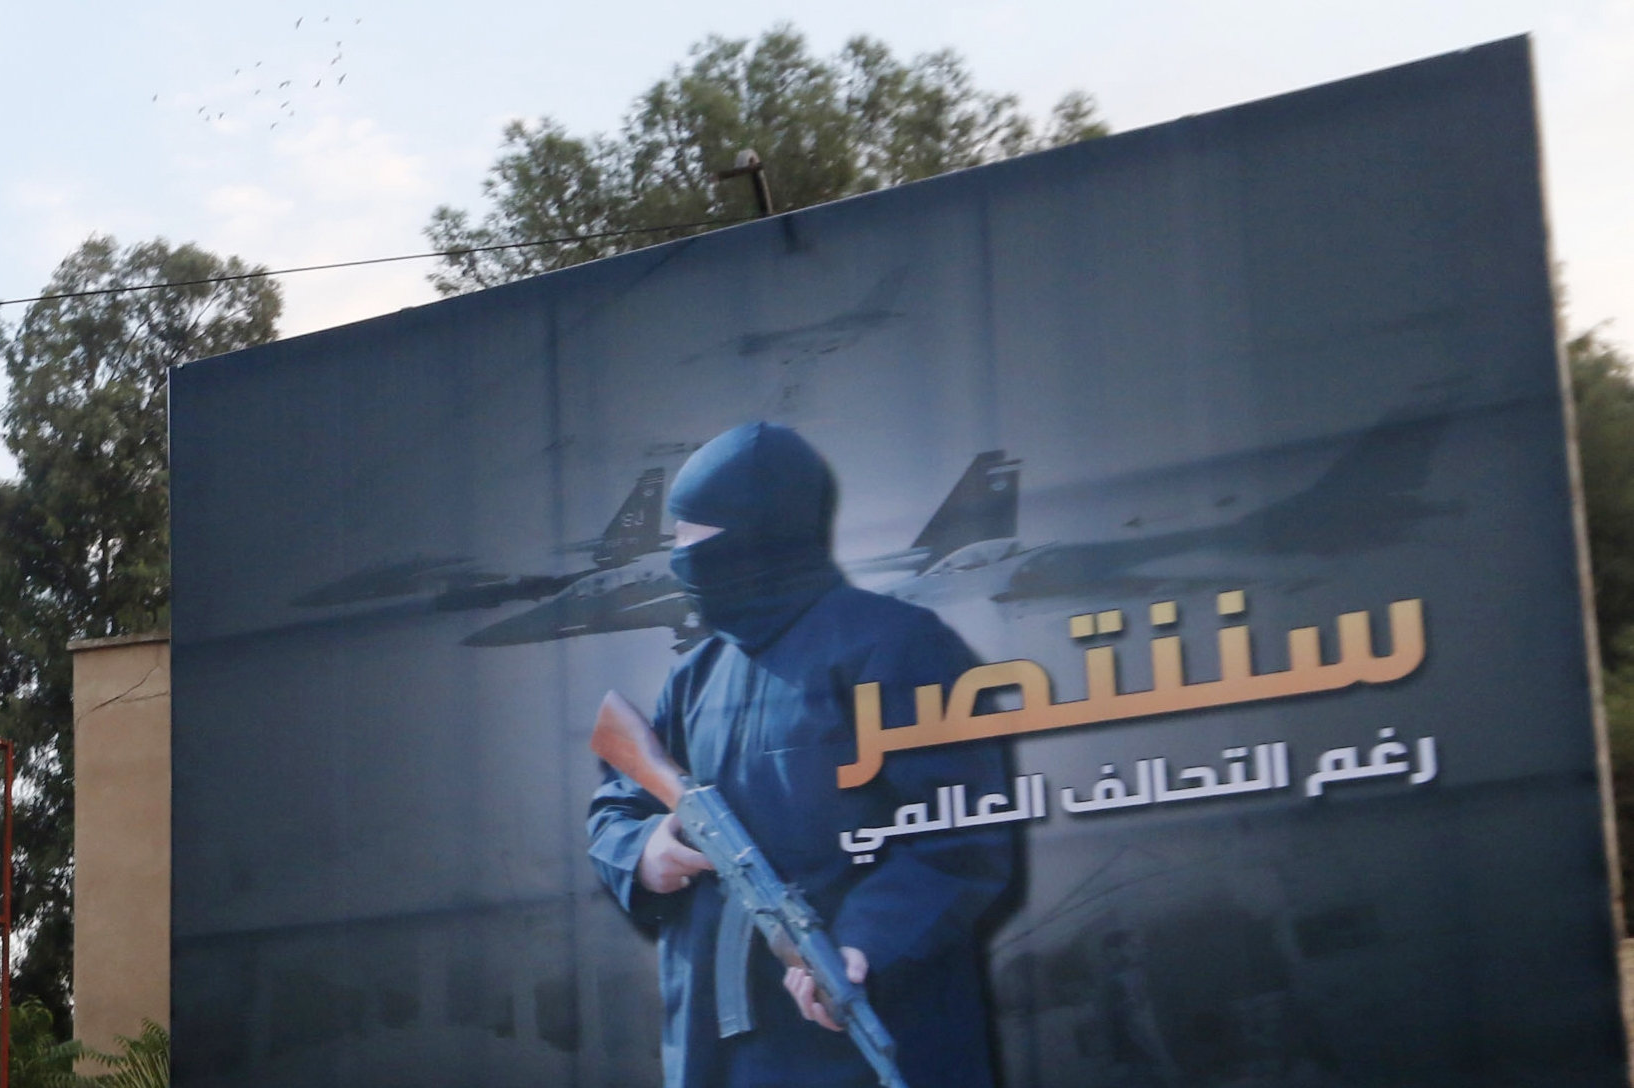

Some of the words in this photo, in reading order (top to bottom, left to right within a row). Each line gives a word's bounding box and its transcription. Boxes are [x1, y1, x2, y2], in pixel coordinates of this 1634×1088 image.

[836, 590, 1426, 789] سننتصر
[1060, 741, 1288, 813] التحالف
[1306, 727, 1436, 797] رغم
[840, 774, 1045, 864] العالمي
